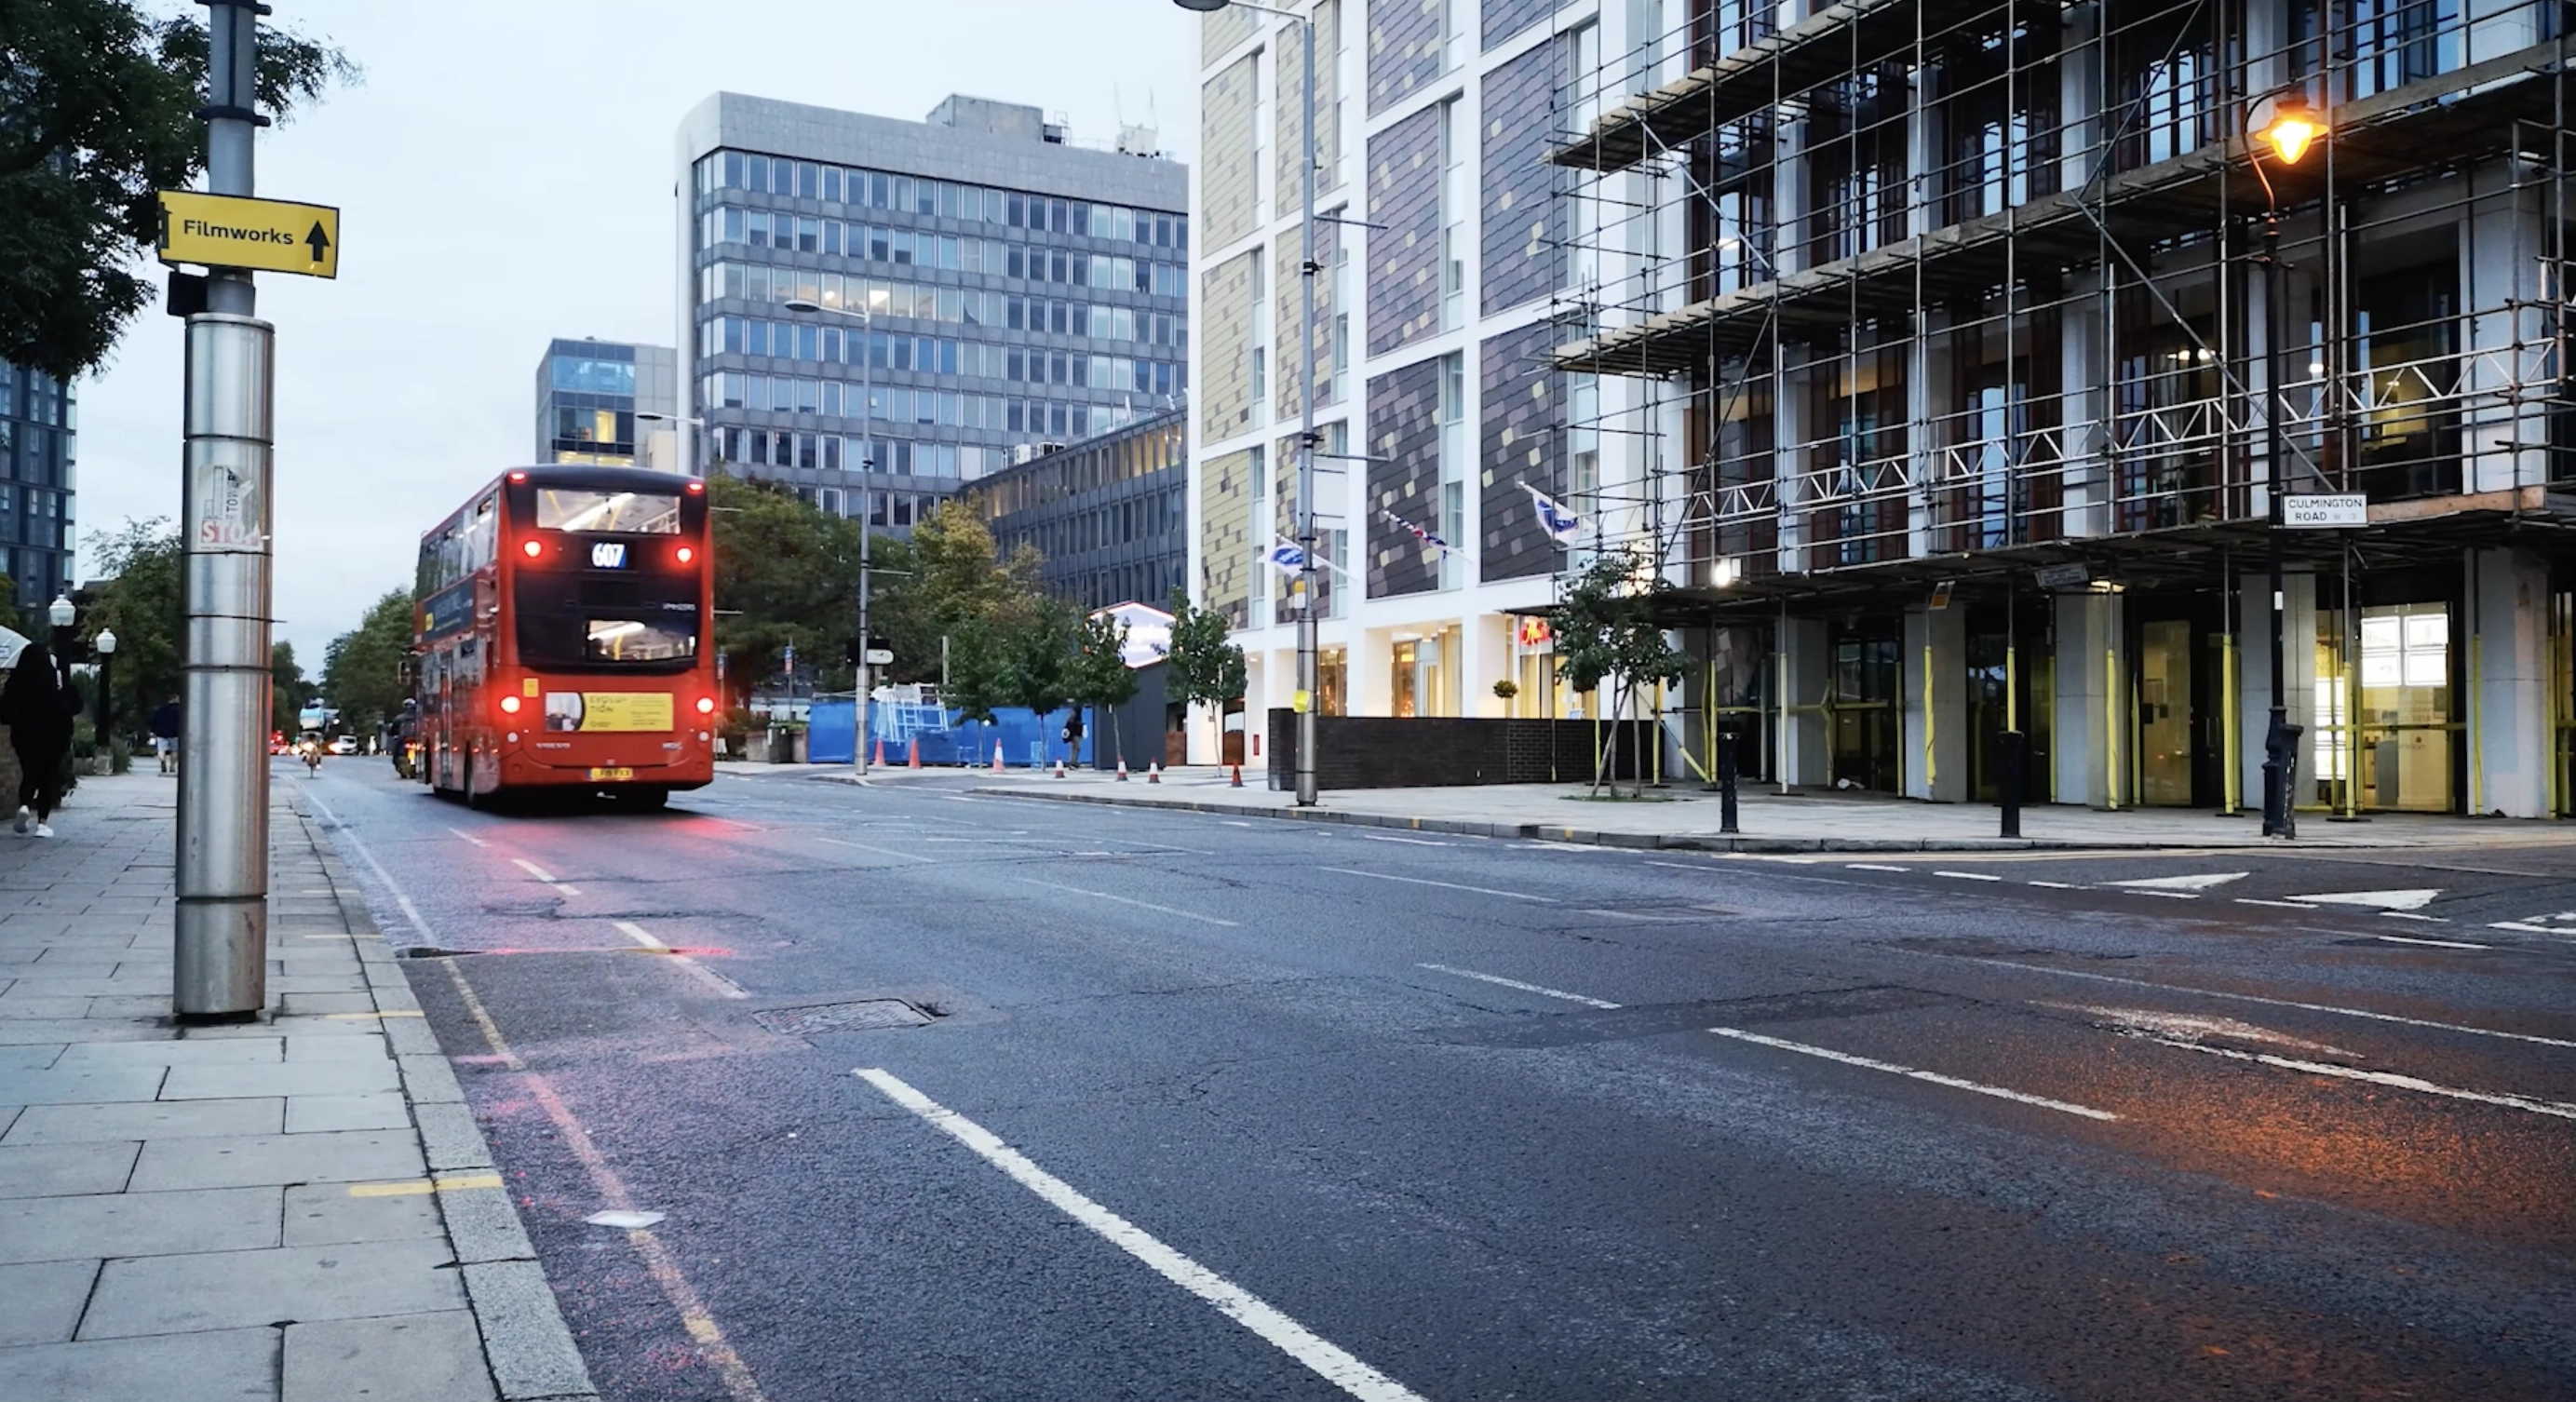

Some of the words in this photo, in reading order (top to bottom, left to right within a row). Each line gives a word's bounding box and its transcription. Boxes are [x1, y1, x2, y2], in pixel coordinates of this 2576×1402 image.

[183, 219, 294, 246] Filmworks
[2288, 498, 2362, 508] CULMINGTON
[2295, 511, 2327, 521] ROAD
[591, 543, 626, 568] 607
